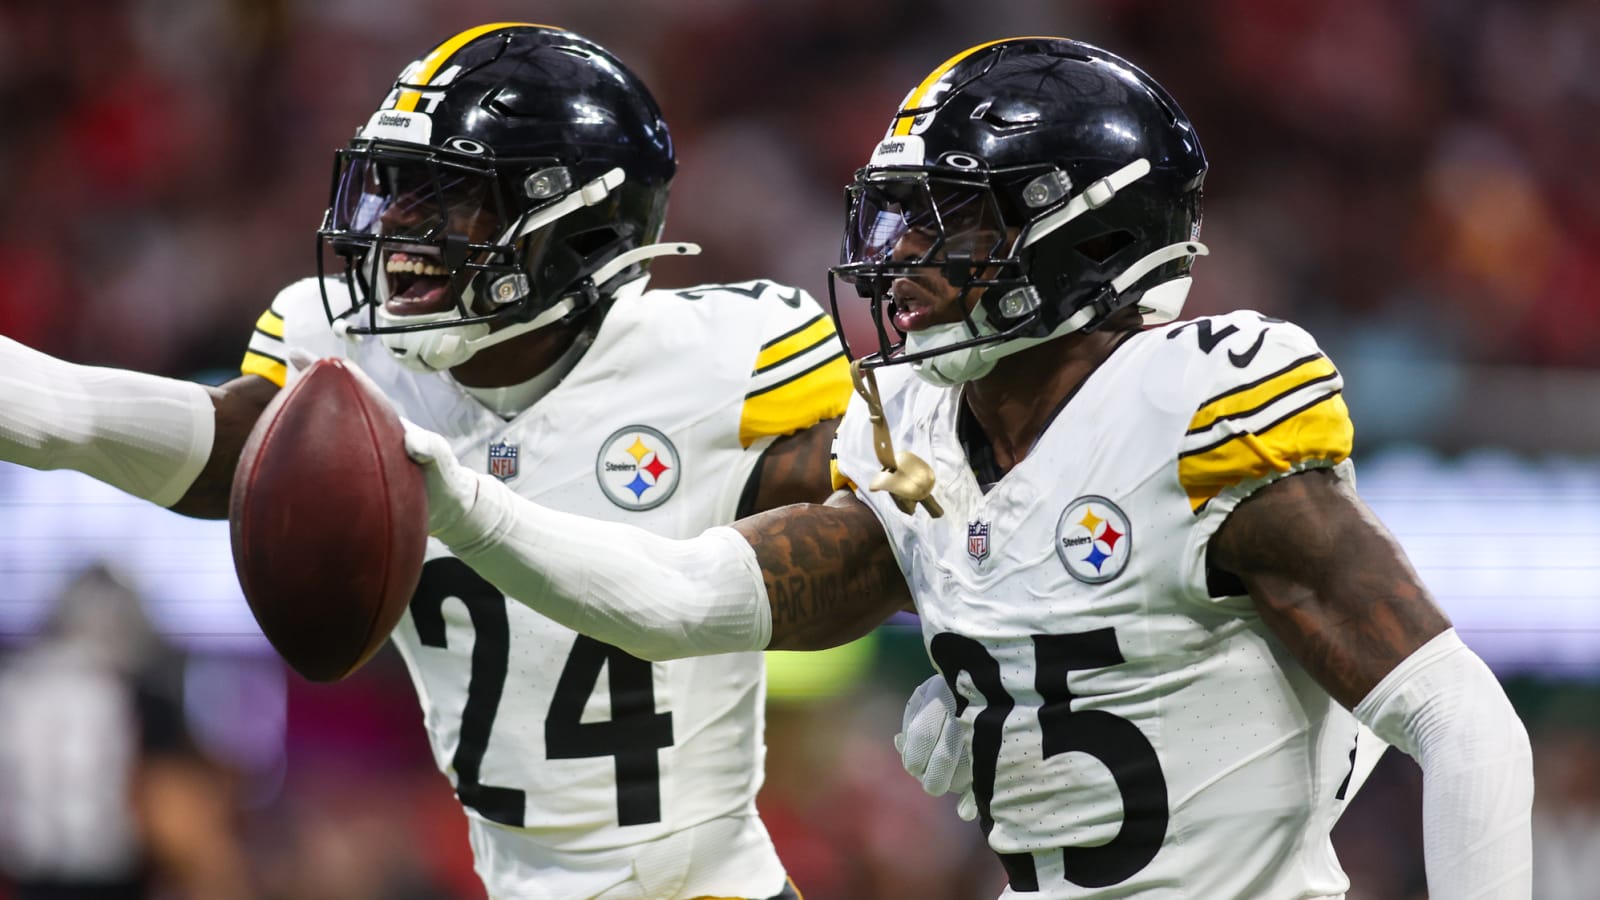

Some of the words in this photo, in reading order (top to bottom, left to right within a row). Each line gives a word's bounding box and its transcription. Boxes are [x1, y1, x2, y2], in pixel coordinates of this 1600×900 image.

[491, 459, 515, 476] NFL
[605, 461, 637, 472] Steelers
[970, 537, 987, 554] NFL
[1062, 535, 1092, 548] Steelers
[409, 556, 674, 828] 24
[930, 626, 1169, 892] 25
